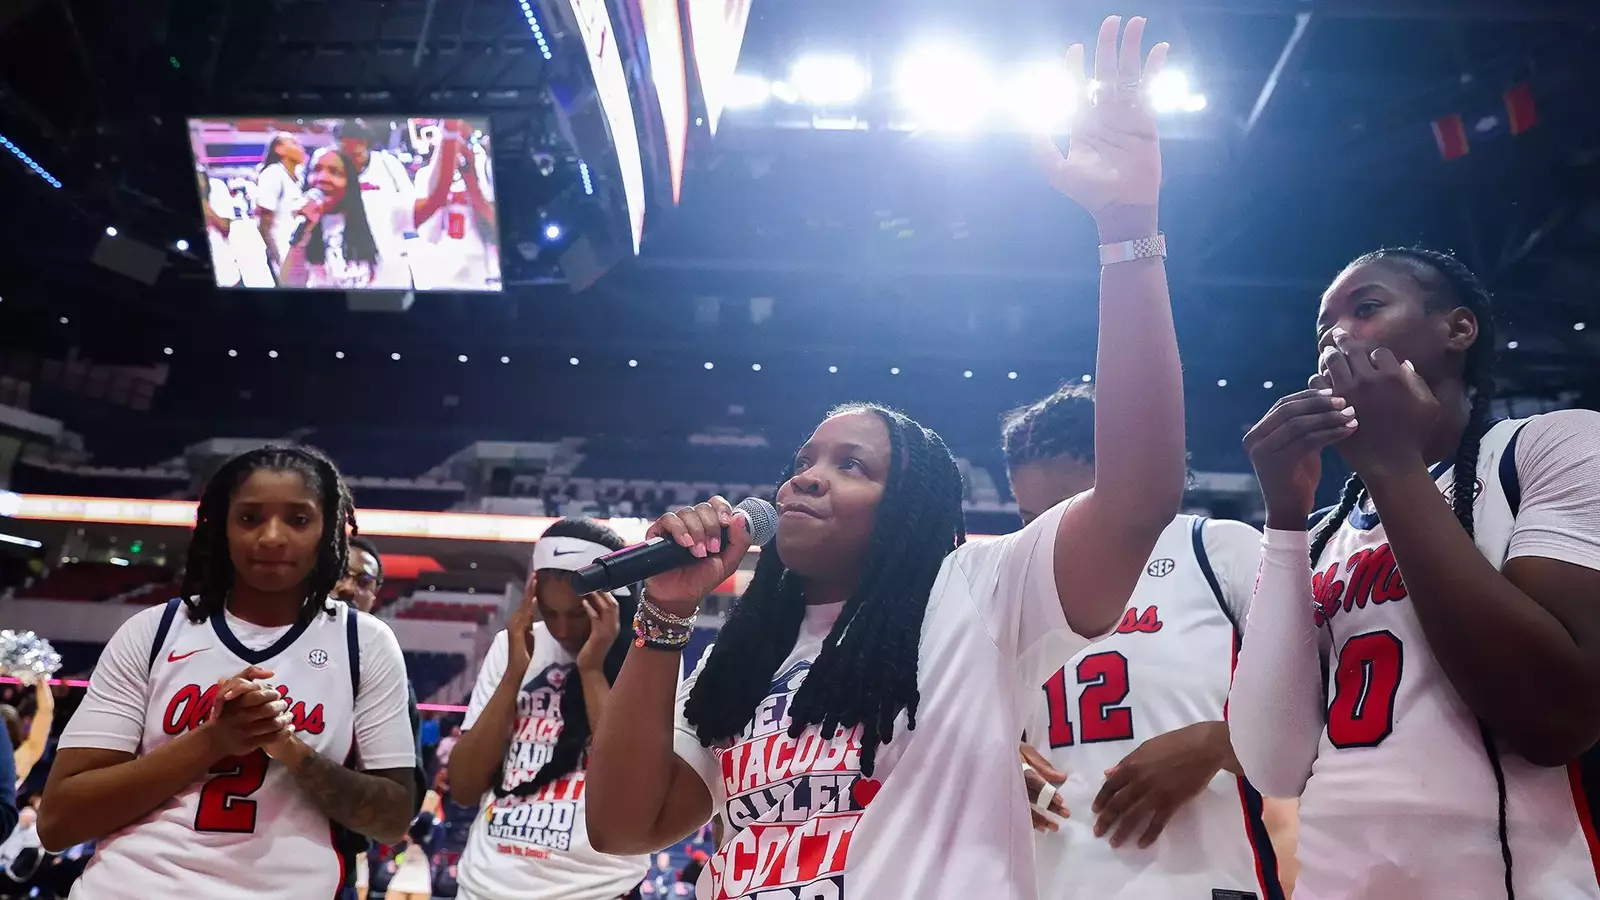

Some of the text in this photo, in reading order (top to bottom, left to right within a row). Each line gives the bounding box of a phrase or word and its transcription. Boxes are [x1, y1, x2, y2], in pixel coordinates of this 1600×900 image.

[1148, 558, 1175, 577] SEC
[309, 649, 328, 665] SEC
[1042, 650, 1134, 750] 12
[1327, 629, 1404, 750] 0
[194, 748, 270, 834] 2
[491, 802, 575, 832] TODD
[488, 824, 571, 851] WILLIAMS
